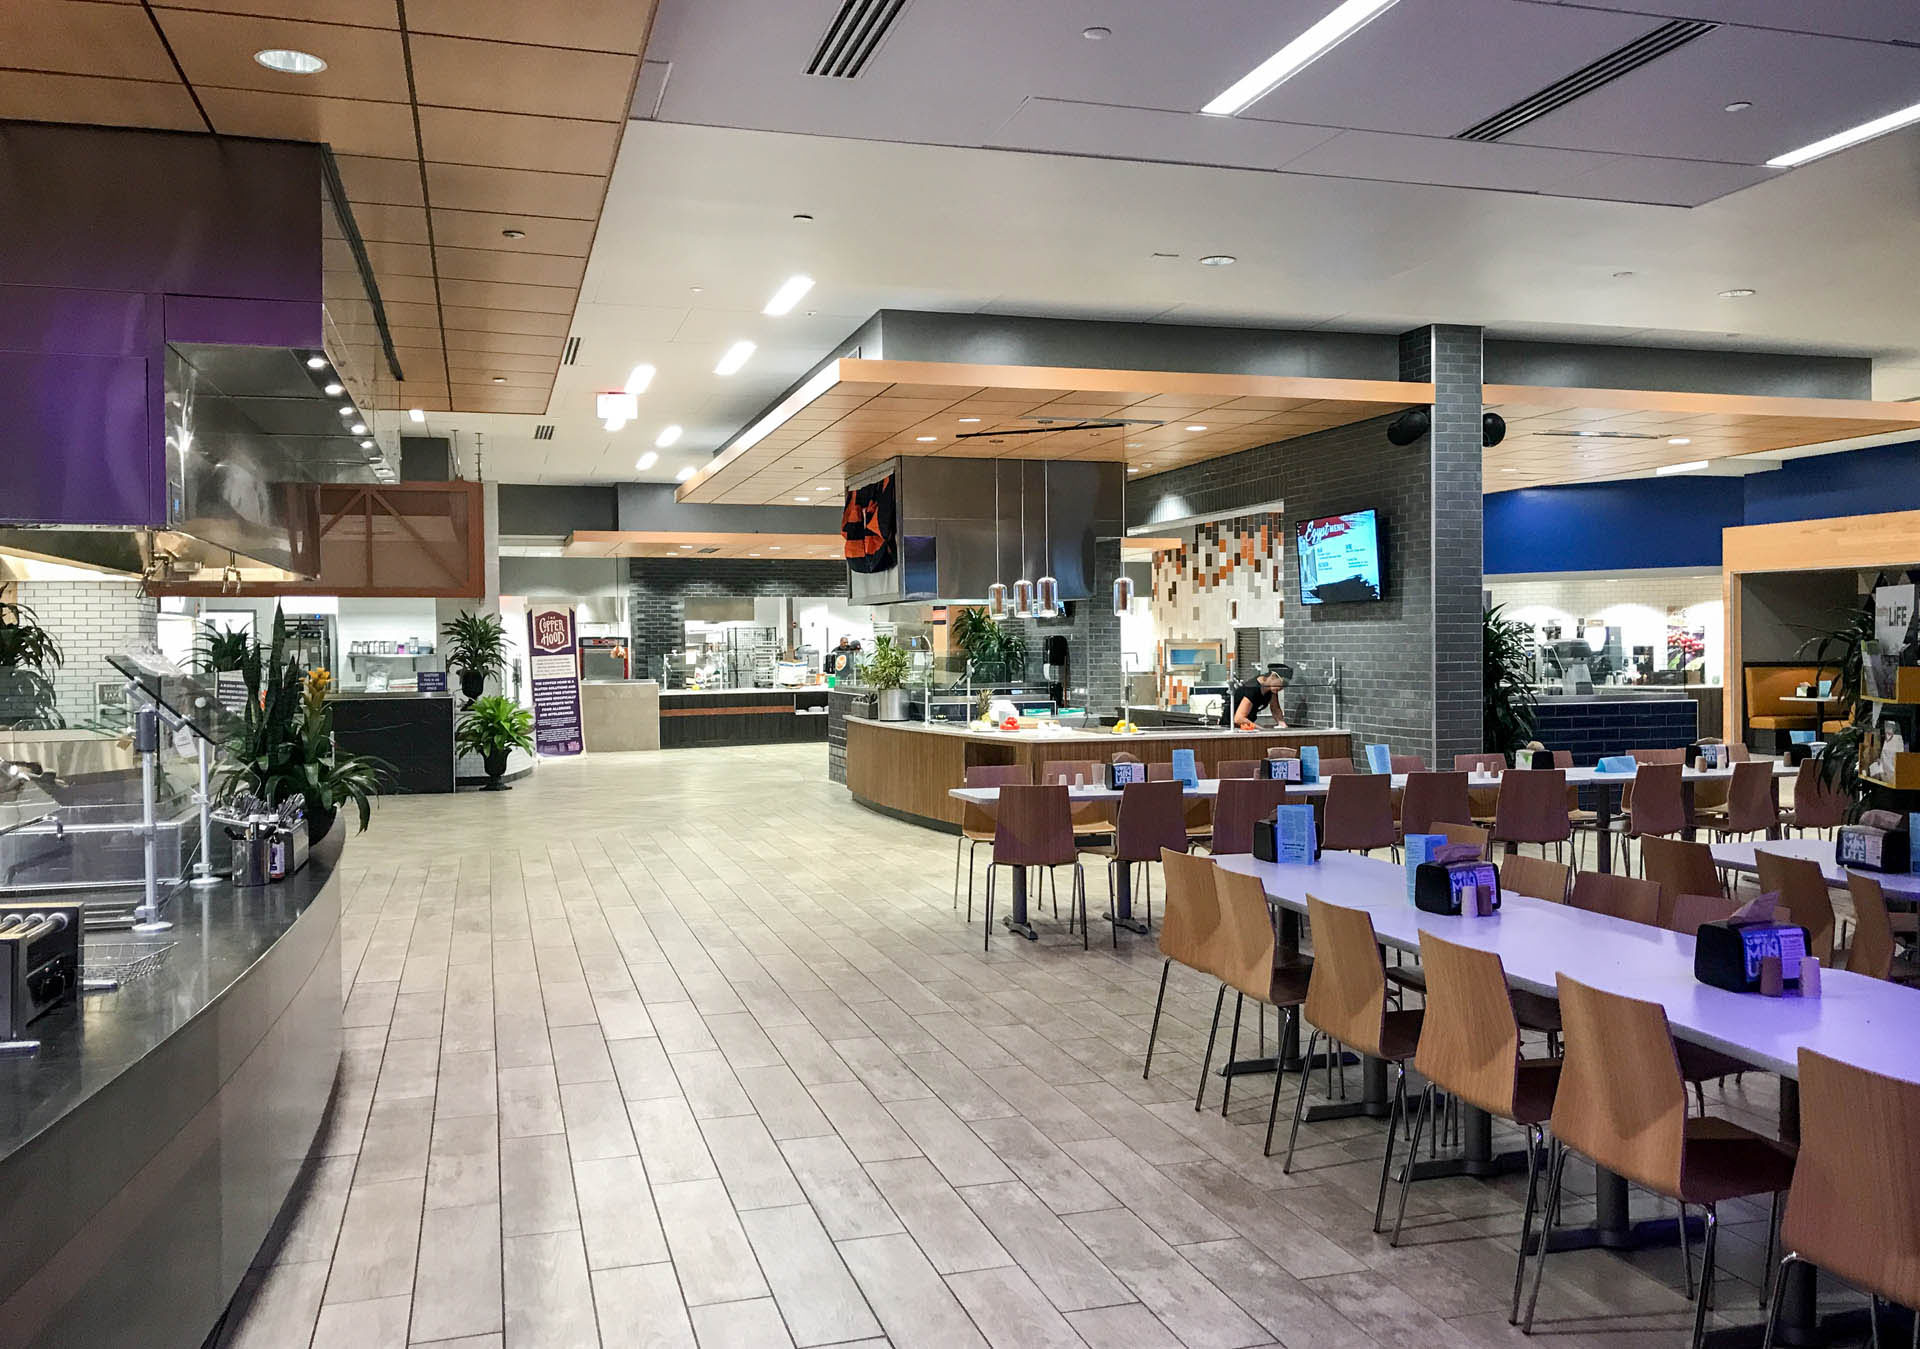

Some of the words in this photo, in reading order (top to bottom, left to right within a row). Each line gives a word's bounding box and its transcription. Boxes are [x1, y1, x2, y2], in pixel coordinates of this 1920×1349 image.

[1305, 520, 1330, 544] Egypt
[539, 617, 565, 634] COPPER
[540, 631, 565, 646] HOOD
[1843, 839, 1865, 851] MIN
[1843, 848, 1865, 861] UTE
[1746, 942, 1780, 960] MIN
